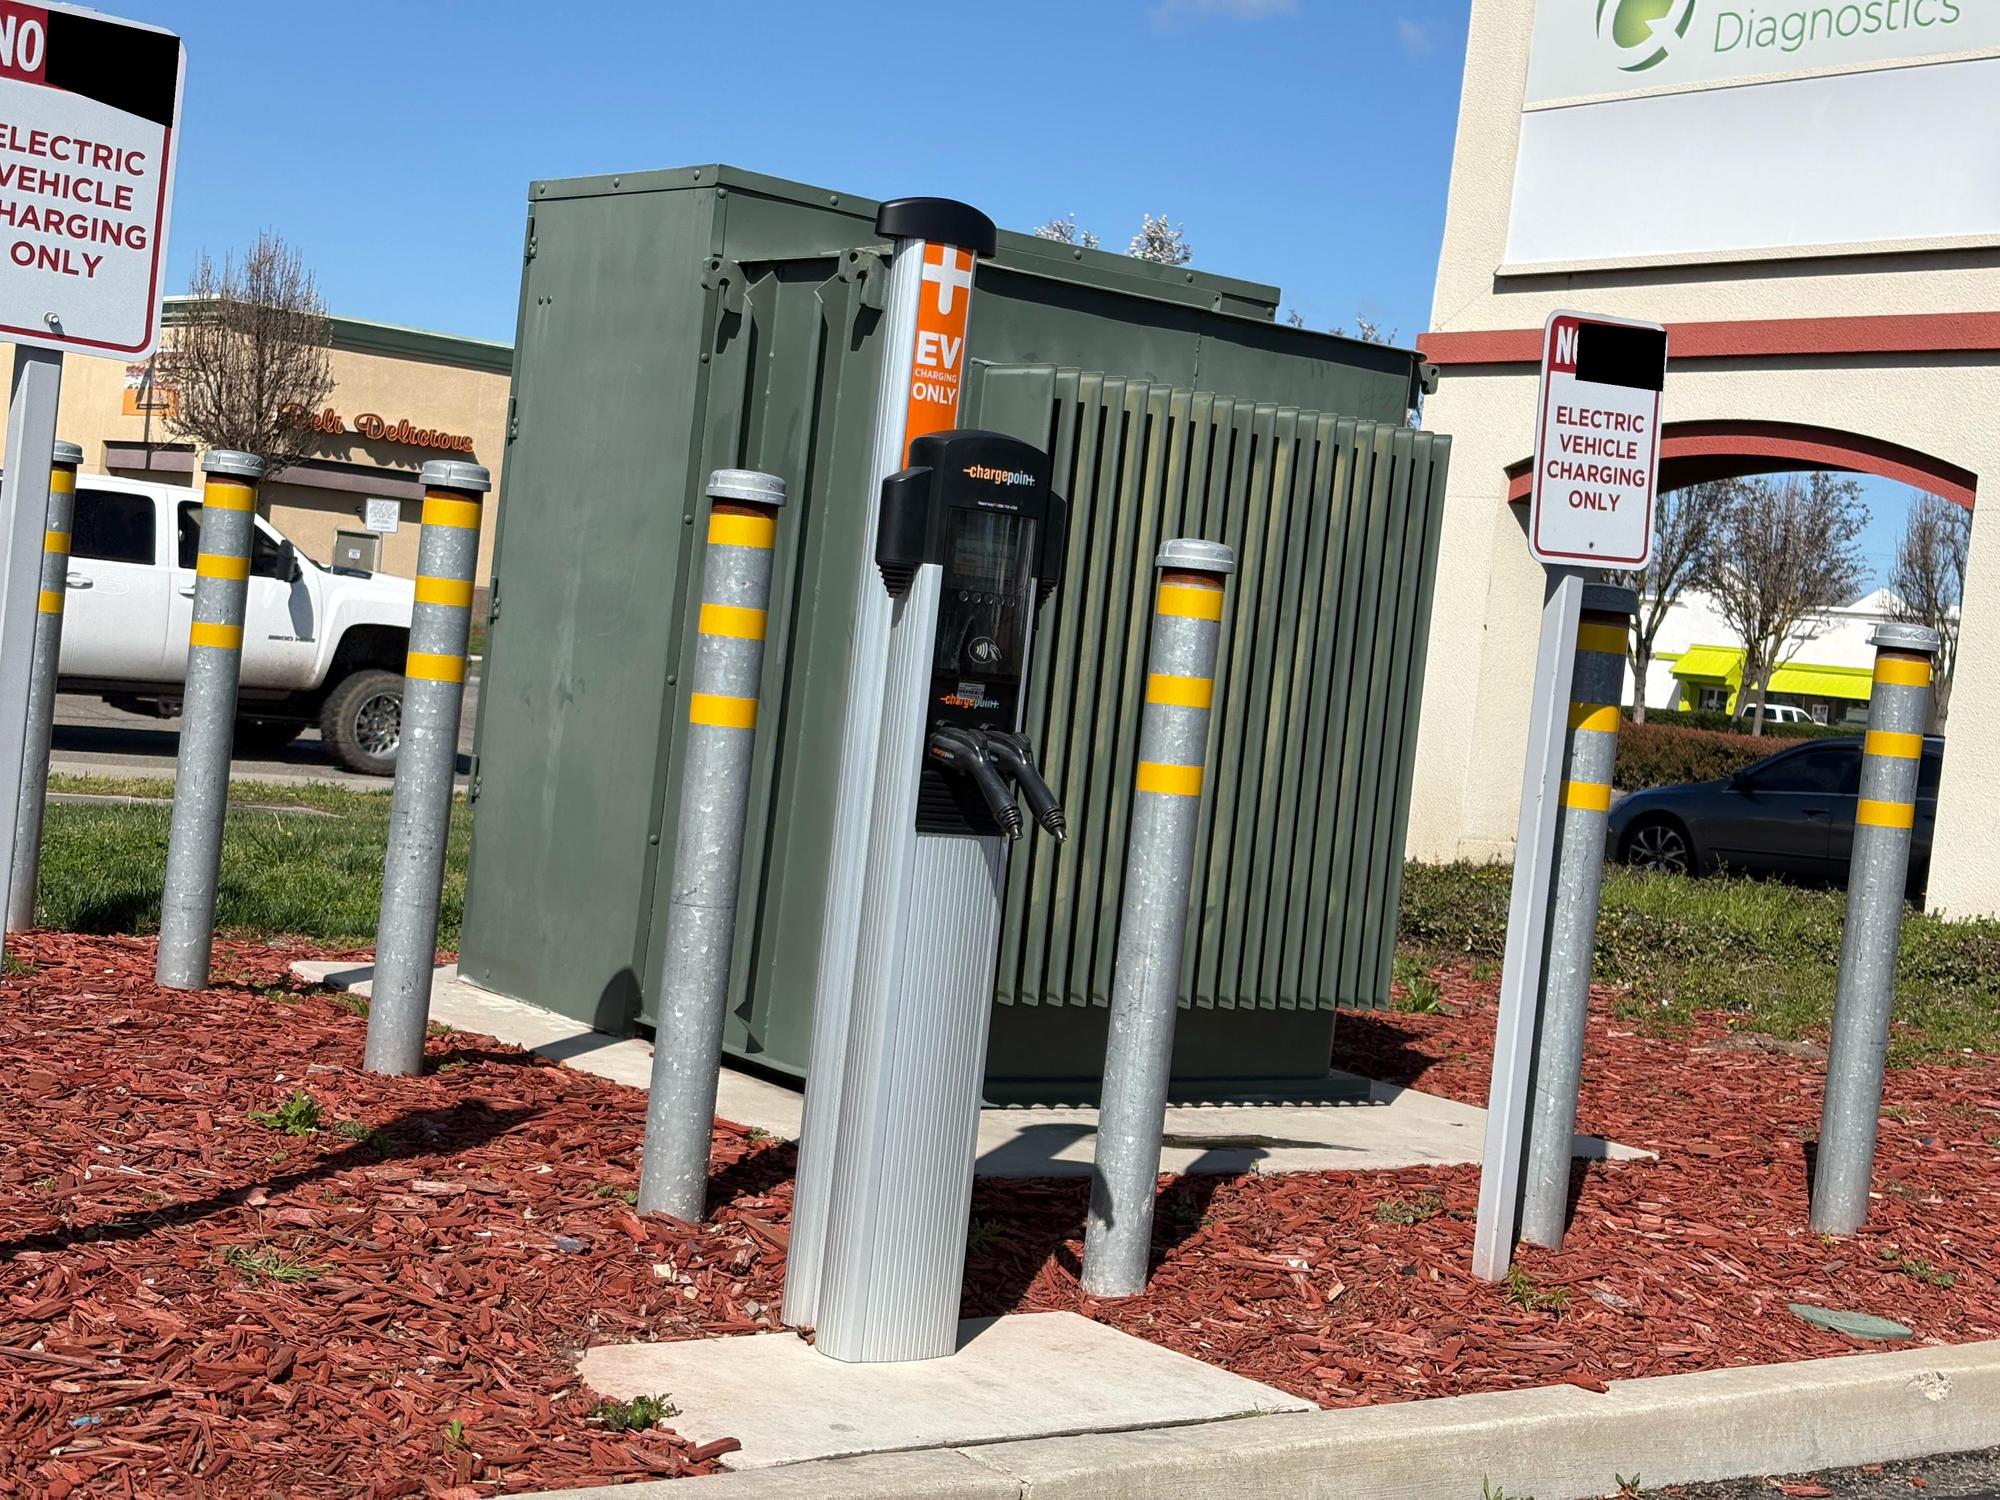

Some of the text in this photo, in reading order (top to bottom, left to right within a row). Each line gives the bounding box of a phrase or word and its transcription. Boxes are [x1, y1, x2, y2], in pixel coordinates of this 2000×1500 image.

[0, 14, 45, 73] NO
[1713, 0, 1961, 53] Diagnostics
[0, 123, 146, 176] ELECTRIC
[0, 162, 134, 212] VEHICLE
[0, 199, 148, 250] HARGING
[10, 240, 104, 279] ONLY
[916, 330, 962, 369] EV
[1555, 325, 1579, 366] N
[913, 382, 957, 405] ONLY
[914, 368, 957, 383] CHARGING
[353, 413, 474, 453] Delicious
[1556, 405, 1645, 433] ELECTRIC
[1560, 434, 1638, 460] VEHICLE
[1547, 460, 1646, 488] CHARGING
[1568, 489, 1621, 512] ONLY
